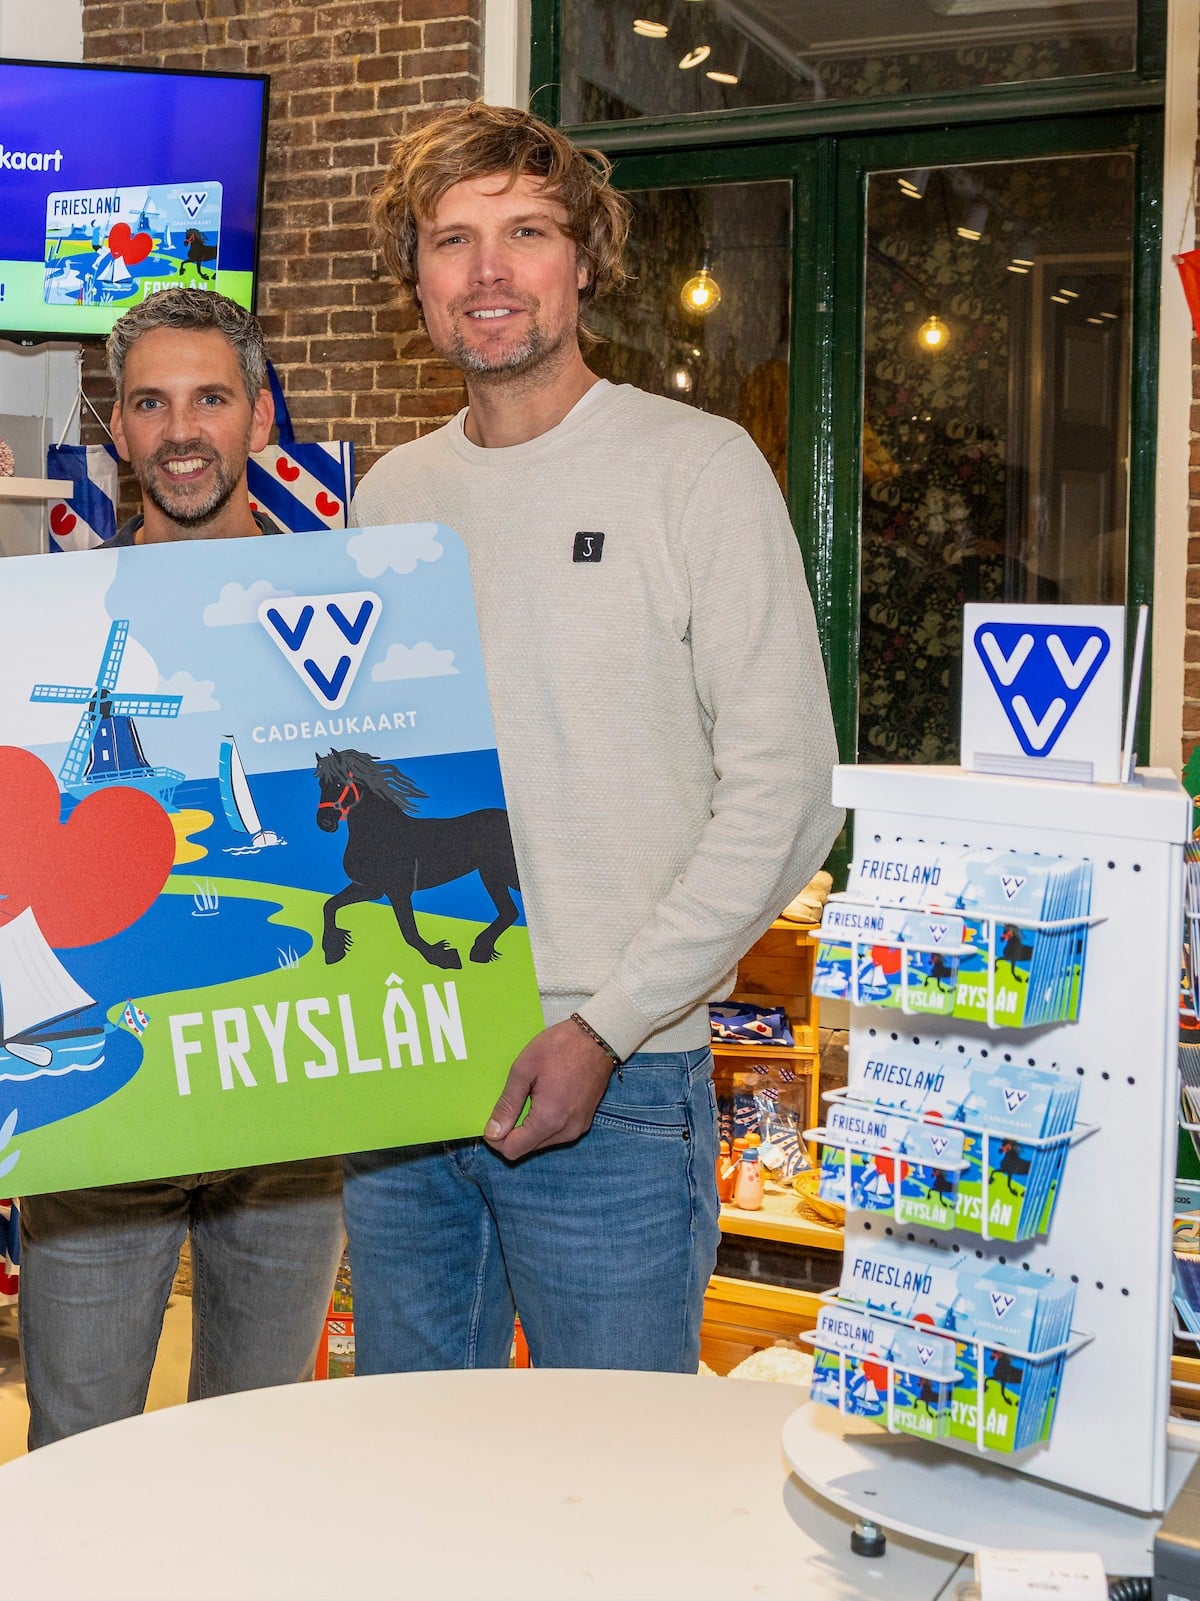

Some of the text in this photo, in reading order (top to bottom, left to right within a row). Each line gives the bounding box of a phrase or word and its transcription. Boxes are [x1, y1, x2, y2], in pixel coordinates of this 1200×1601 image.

[54, 196, 121, 216] FRIESLAND
[582, 537, 594, 557] J
[252, 710, 418, 744] CADEAUKAART
[861, 859, 941, 887] FRIESLAND
[827, 911, 885, 932] FRIESLAND
[895, 987, 945, 1009] FYSLÂN
[168, 972, 468, 1096] FRYSLÂN
[863, 1060, 945, 1093] FRIESLAND
[832, 1113, 888, 1138] FRIESLAND
[852, 1258, 933, 1295] FRIESLAND
[822, 1316, 875, 1344] FRIESLAND
[893, 1408, 934, 1435] RYSLÂN
